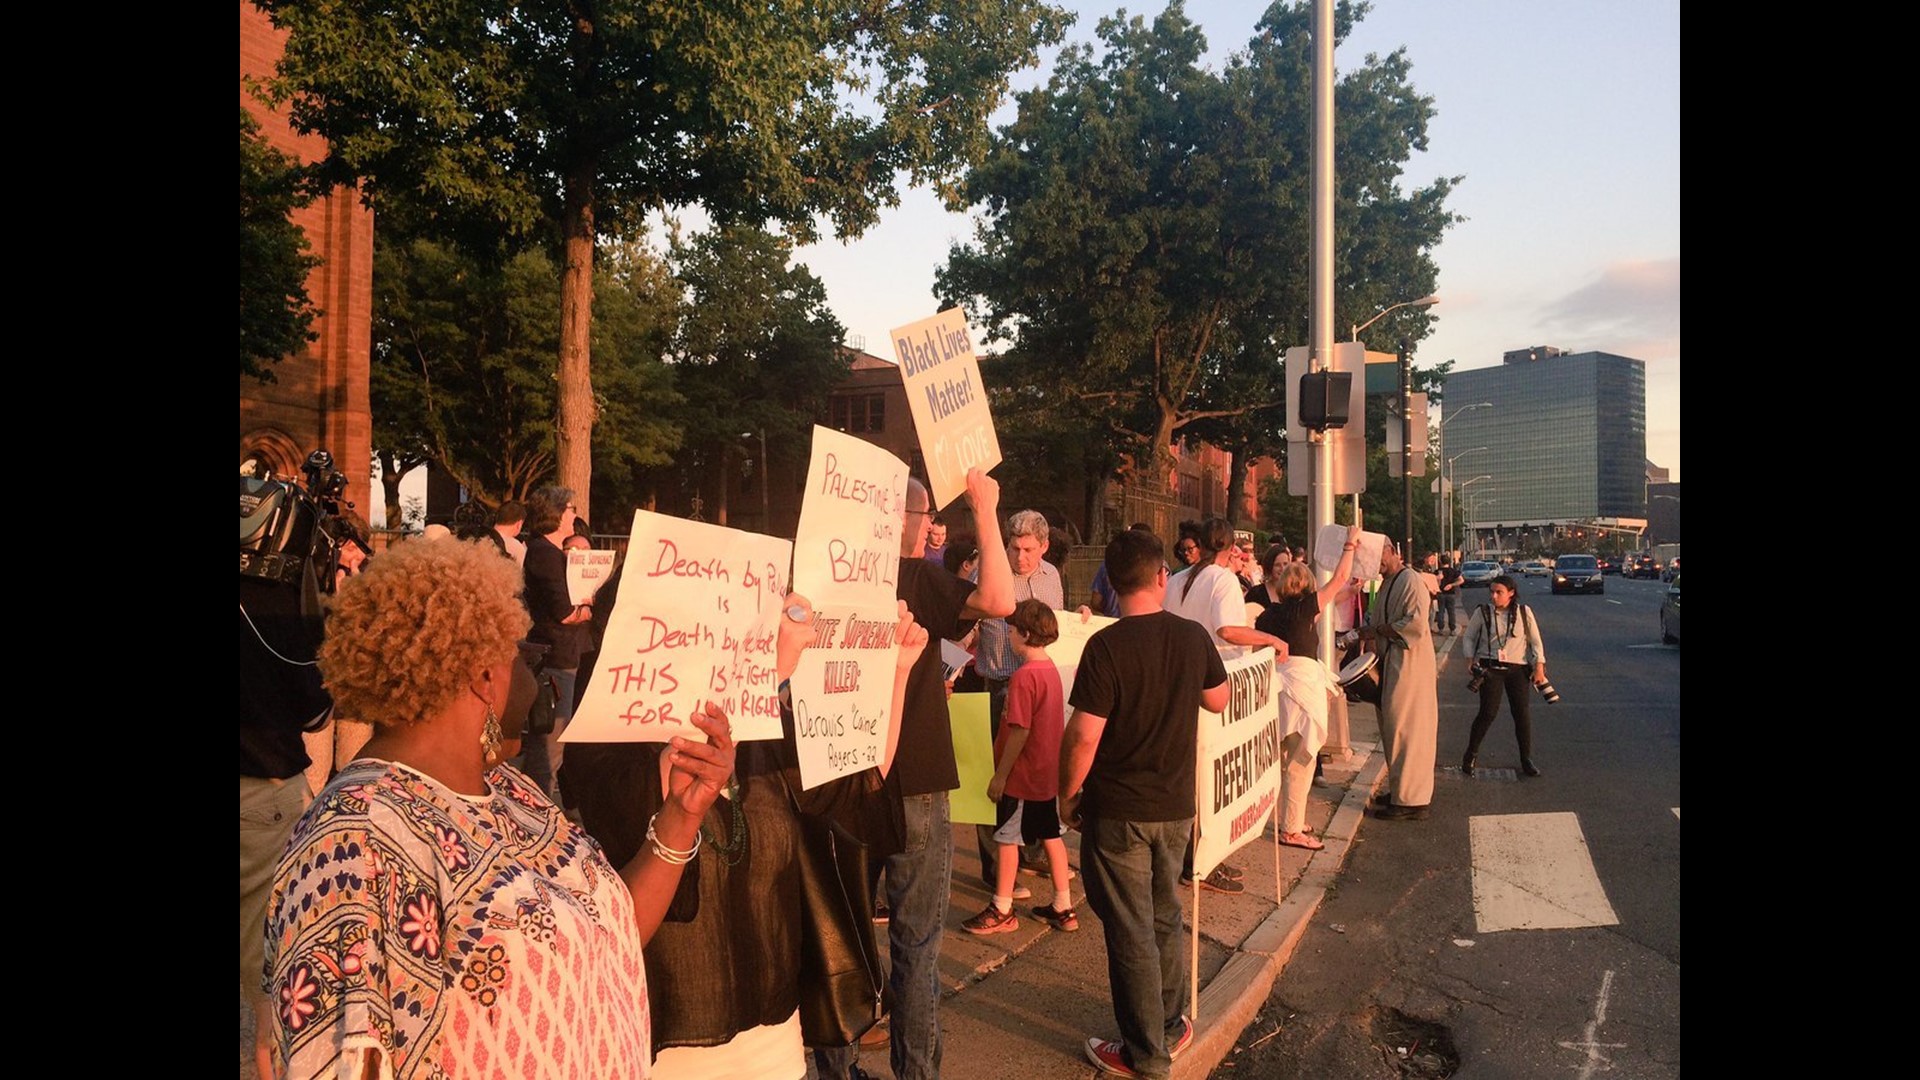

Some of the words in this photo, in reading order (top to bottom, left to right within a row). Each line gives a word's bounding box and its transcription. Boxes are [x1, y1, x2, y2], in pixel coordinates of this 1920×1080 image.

[898, 329, 941, 378] Black
[936, 323, 971, 362] Lives
[925, 367, 975, 423] Matter!
[955, 425, 992, 477] LOVE
[822, 453, 889, 515] PALESTINE
[647, 538, 730, 583] Death
[743, 559, 761, 614] by
[829, 539, 882, 587] BLACK
[636, 616, 715, 653] Death
[722, 627, 738, 664] by
[608, 662, 679, 694] THIS
[709, 665, 728, 693] IS
[824, 660, 861, 694] KILLED:
[1213, 739, 1253, 815] DEFEAT
[1253, 717, 1280, 784] RACISM
